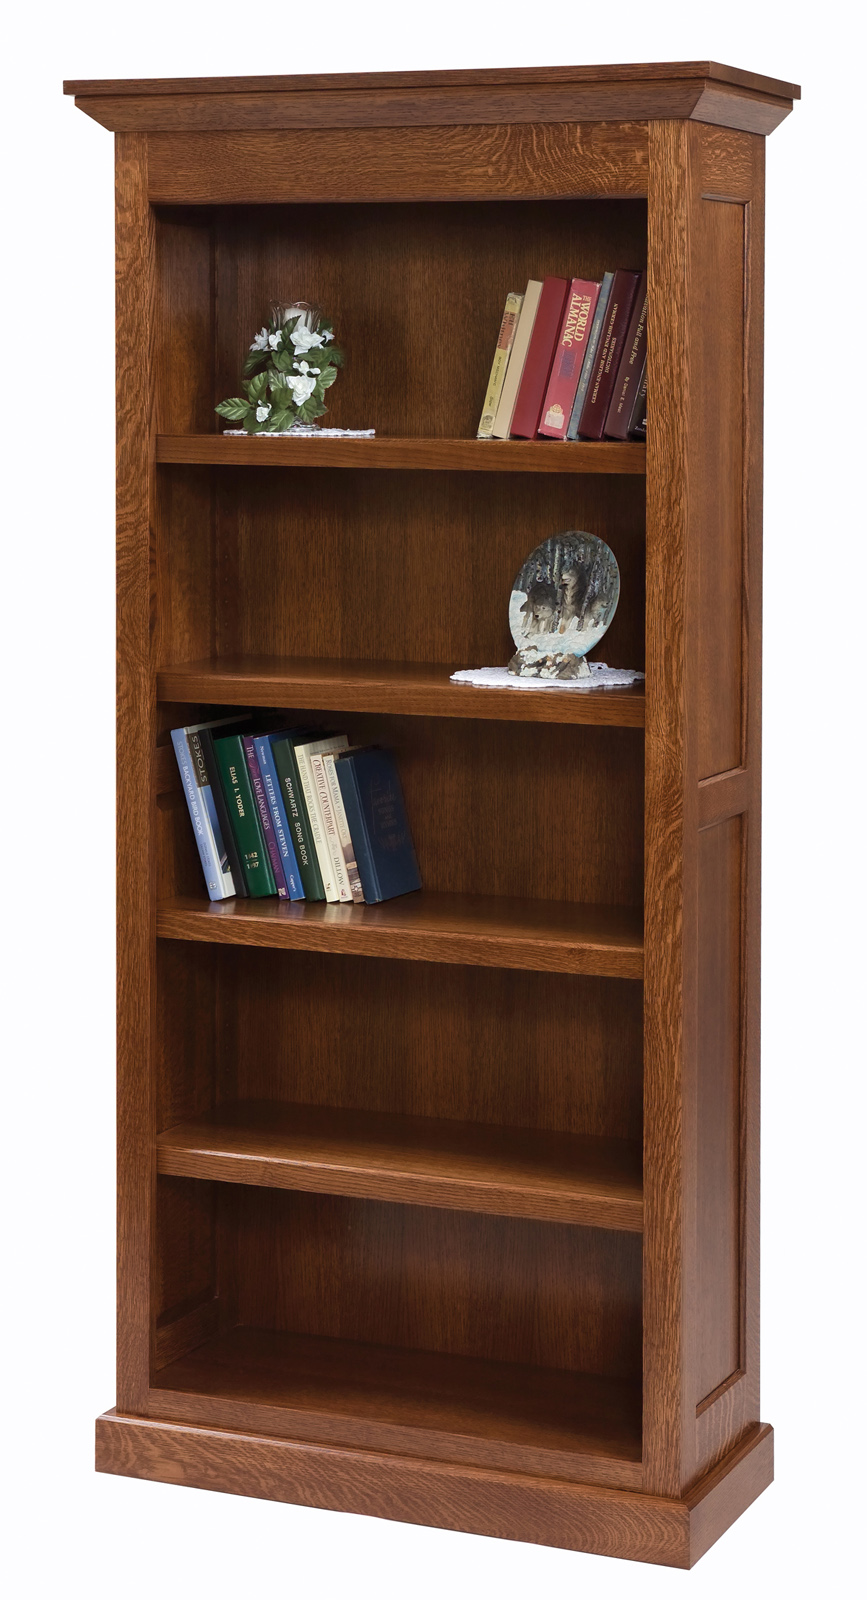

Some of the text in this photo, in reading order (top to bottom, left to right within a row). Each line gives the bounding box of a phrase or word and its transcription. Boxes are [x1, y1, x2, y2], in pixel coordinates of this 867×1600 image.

[561, 293, 582, 347] ALMANAC
[574, 301, 591, 342] WORLD
[636, 324, 644, 338] Full
[604, 337, 617, 374] DICTIONARIES
[629, 350, 638, 365] Free
[631, 338, 640, 351] and
[192, 735, 207, 782] STOKES
[246, 744, 255, 759] THE
[253, 778, 262, 794] LOVE
[300, 765, 308, 780] HAND
[303, 780, 311, 794] THAT
[313, 759, 326, 790] CREATIVE
[177, 741, 204, 835] STOKES BACKYARD BIRD BOOK
[229, 766, 238, 784] ELIAS
[235, 794, 245, 817] YODER
[306, 793, 314, 813] ROCKS
[332, 786, 340, 805] MAMA
[257, 793, 270, 830] LANGUAGES
[265, 774, 289, 857] LETTERS FROM STEVEN
[284, 777, 309, 866] SCHWARTZ SONG BOOK
[319, 791, 336, 835] COUNTERPART
[312, 823, 322, 844] CRADLE
[334, 857, 345, 886] DILLOW
